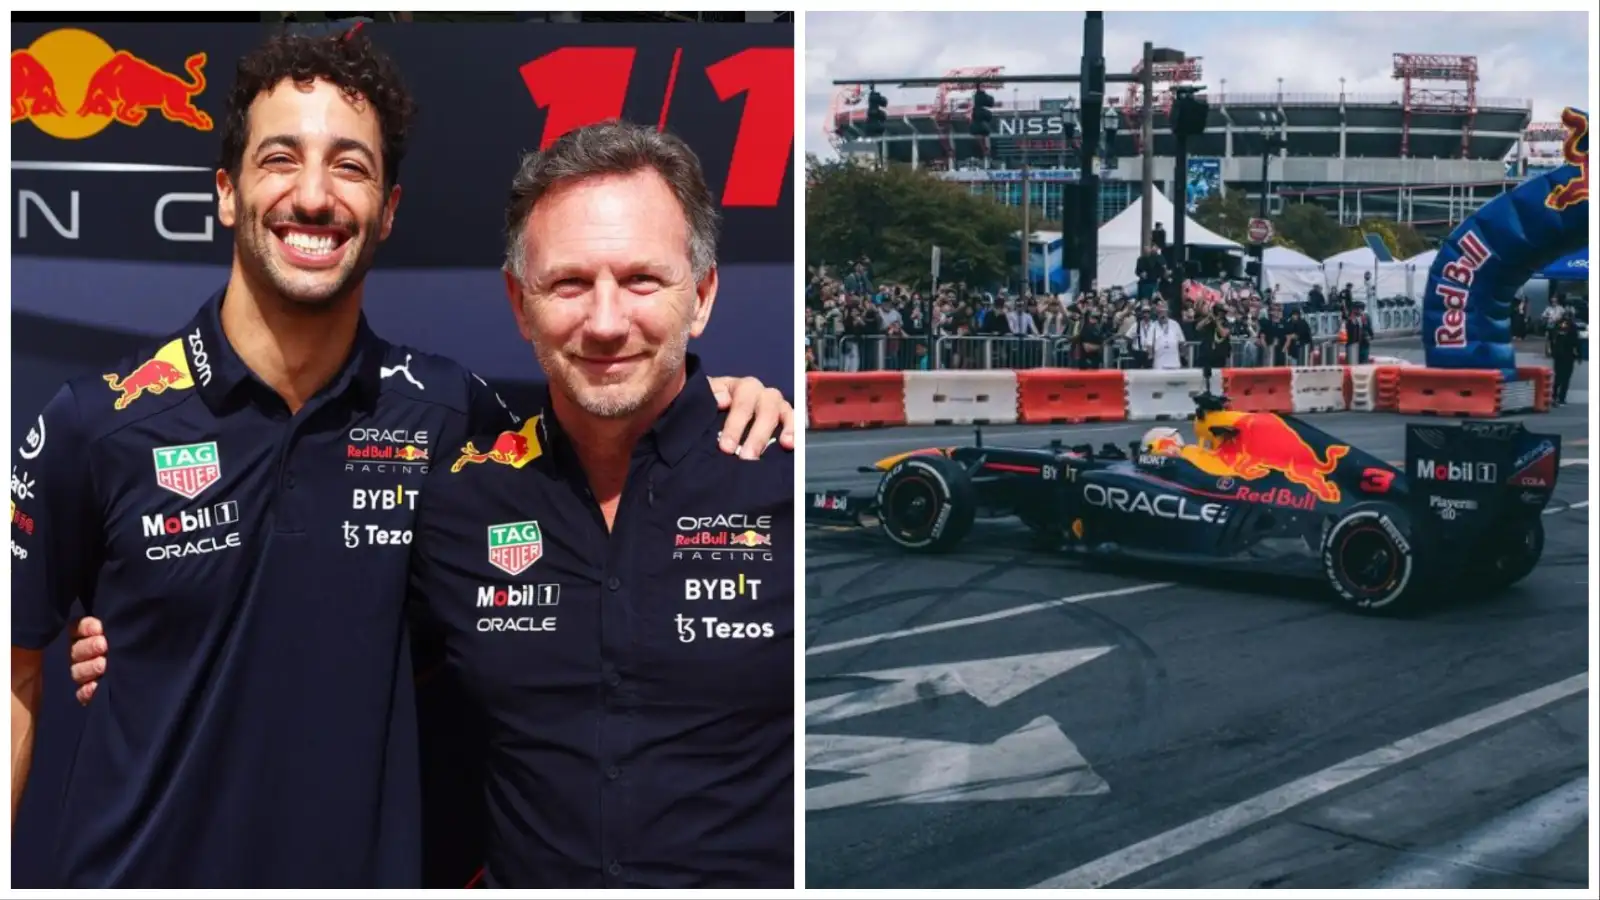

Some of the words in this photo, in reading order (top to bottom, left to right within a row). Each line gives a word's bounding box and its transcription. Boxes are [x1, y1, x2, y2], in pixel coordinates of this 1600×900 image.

[999, 117, 1082, 135] NISS
[1442, 230, 1492, 287] Bull
[1436, 284, 1468, 348] Red
[188, 328, 213, 387] zoom
[349, 428, 428, 444] ORACLE
[159, 447, 212, 467] TAG
[347, 444, 370, 458] Red
[370, 445, 392, 459] Bull
[160, 465, 217, 494] HEUER
[345, 463, 429, 475] RACING
[1417, 459, 1473, 481] Mobil
[1360, 468, 1396, 494] 3
[352, 484, 419, 510] BYBIT
[1083, 483, 1227, 524] ORACLE
[1236, 485, 1277, 503] Red
[1276, 487, 1318, 511] Bull
[142, 507, 211, 537] Mobil
[676, 514, 772, 530] ORACLE
[492, 525, 537, 544] TAG
[675, 532, 700, 546] Red
[701, 531, 727, 545] Bull
[146, 532, 241, 560] ORACLE
[673, 552, 773, 561] RACING
[492, 544, 539, 572] HEUER
[476, 585, 534, 607] Mobil
[685, 573, 761, 600] BYBIT
[477, 617, 557, 632] ORACLE
[702, 617, 774, 638] Tezos
